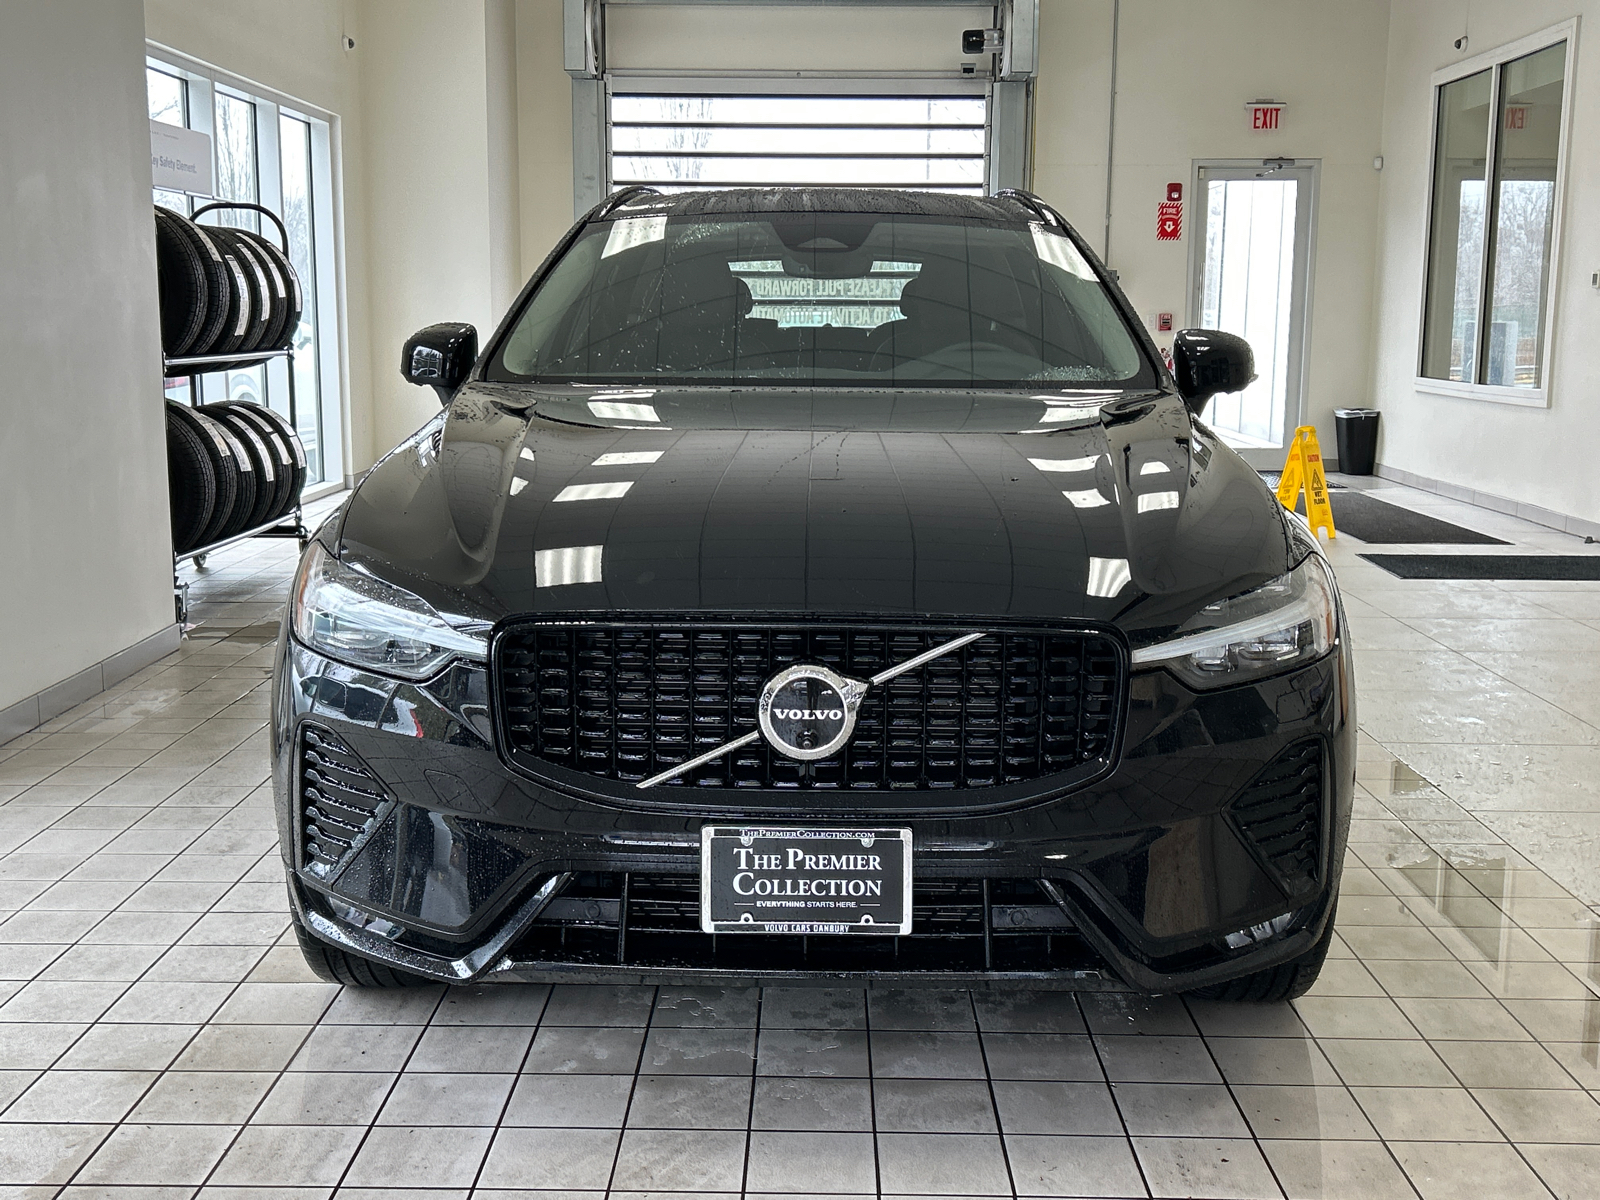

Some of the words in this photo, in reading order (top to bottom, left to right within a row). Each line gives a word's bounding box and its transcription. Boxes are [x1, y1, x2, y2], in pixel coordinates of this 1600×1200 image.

[1253, 108, 1281, 129] EXIT
[160, 155, 175, 171] Safety
[773, 709, 843, 720] VOLVO
[733, 848, 782, 870] THE
[786, 848, 882, 871] PREMIER
[732, 872, 882, 896] COLLECTION
[764, 924, 789, 932] VOLVO
[791, 924, 811, 932] CARS
[813, 925, 850, 933] DANBURY
